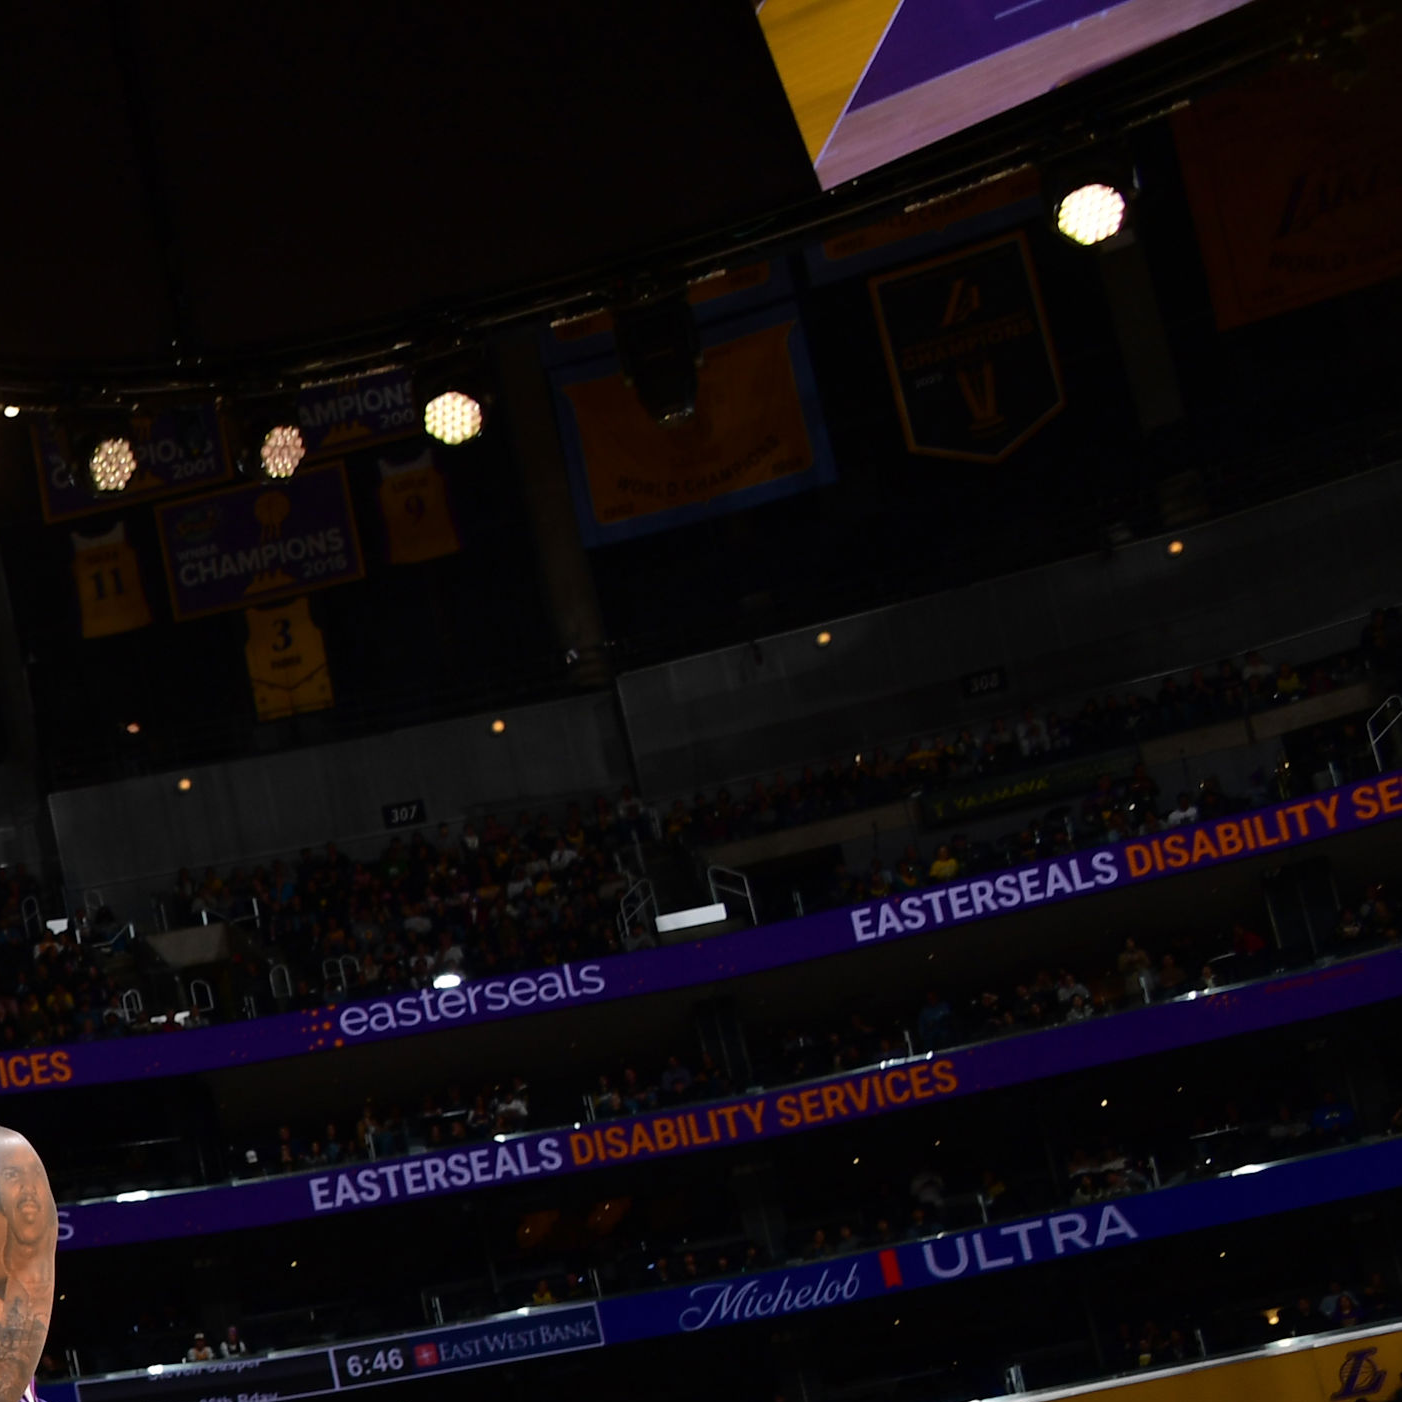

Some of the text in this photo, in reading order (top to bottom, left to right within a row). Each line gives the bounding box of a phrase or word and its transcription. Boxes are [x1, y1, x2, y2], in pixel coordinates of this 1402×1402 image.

[178, 527, 345, 589] CHAMPIONS
[302, 554, 348, 579] 2016
[92, 568, 125, 600] 11
[271, 619, 292, 653] 3
[390, 805, 417, 824] 307
[851, 850, 1120, 943] EASTERSEALS
[1126, 788, 1340, 879] DISABILITY
[338, 961, 606, 1038] easterseals
[310, 1059, 959, 1212] EASTERSEALS DISABILITY SERVICES
[678, 1202, 1139, 1334] Michelob ULTRA
[346, 1347, 404, 1378] 6:46
